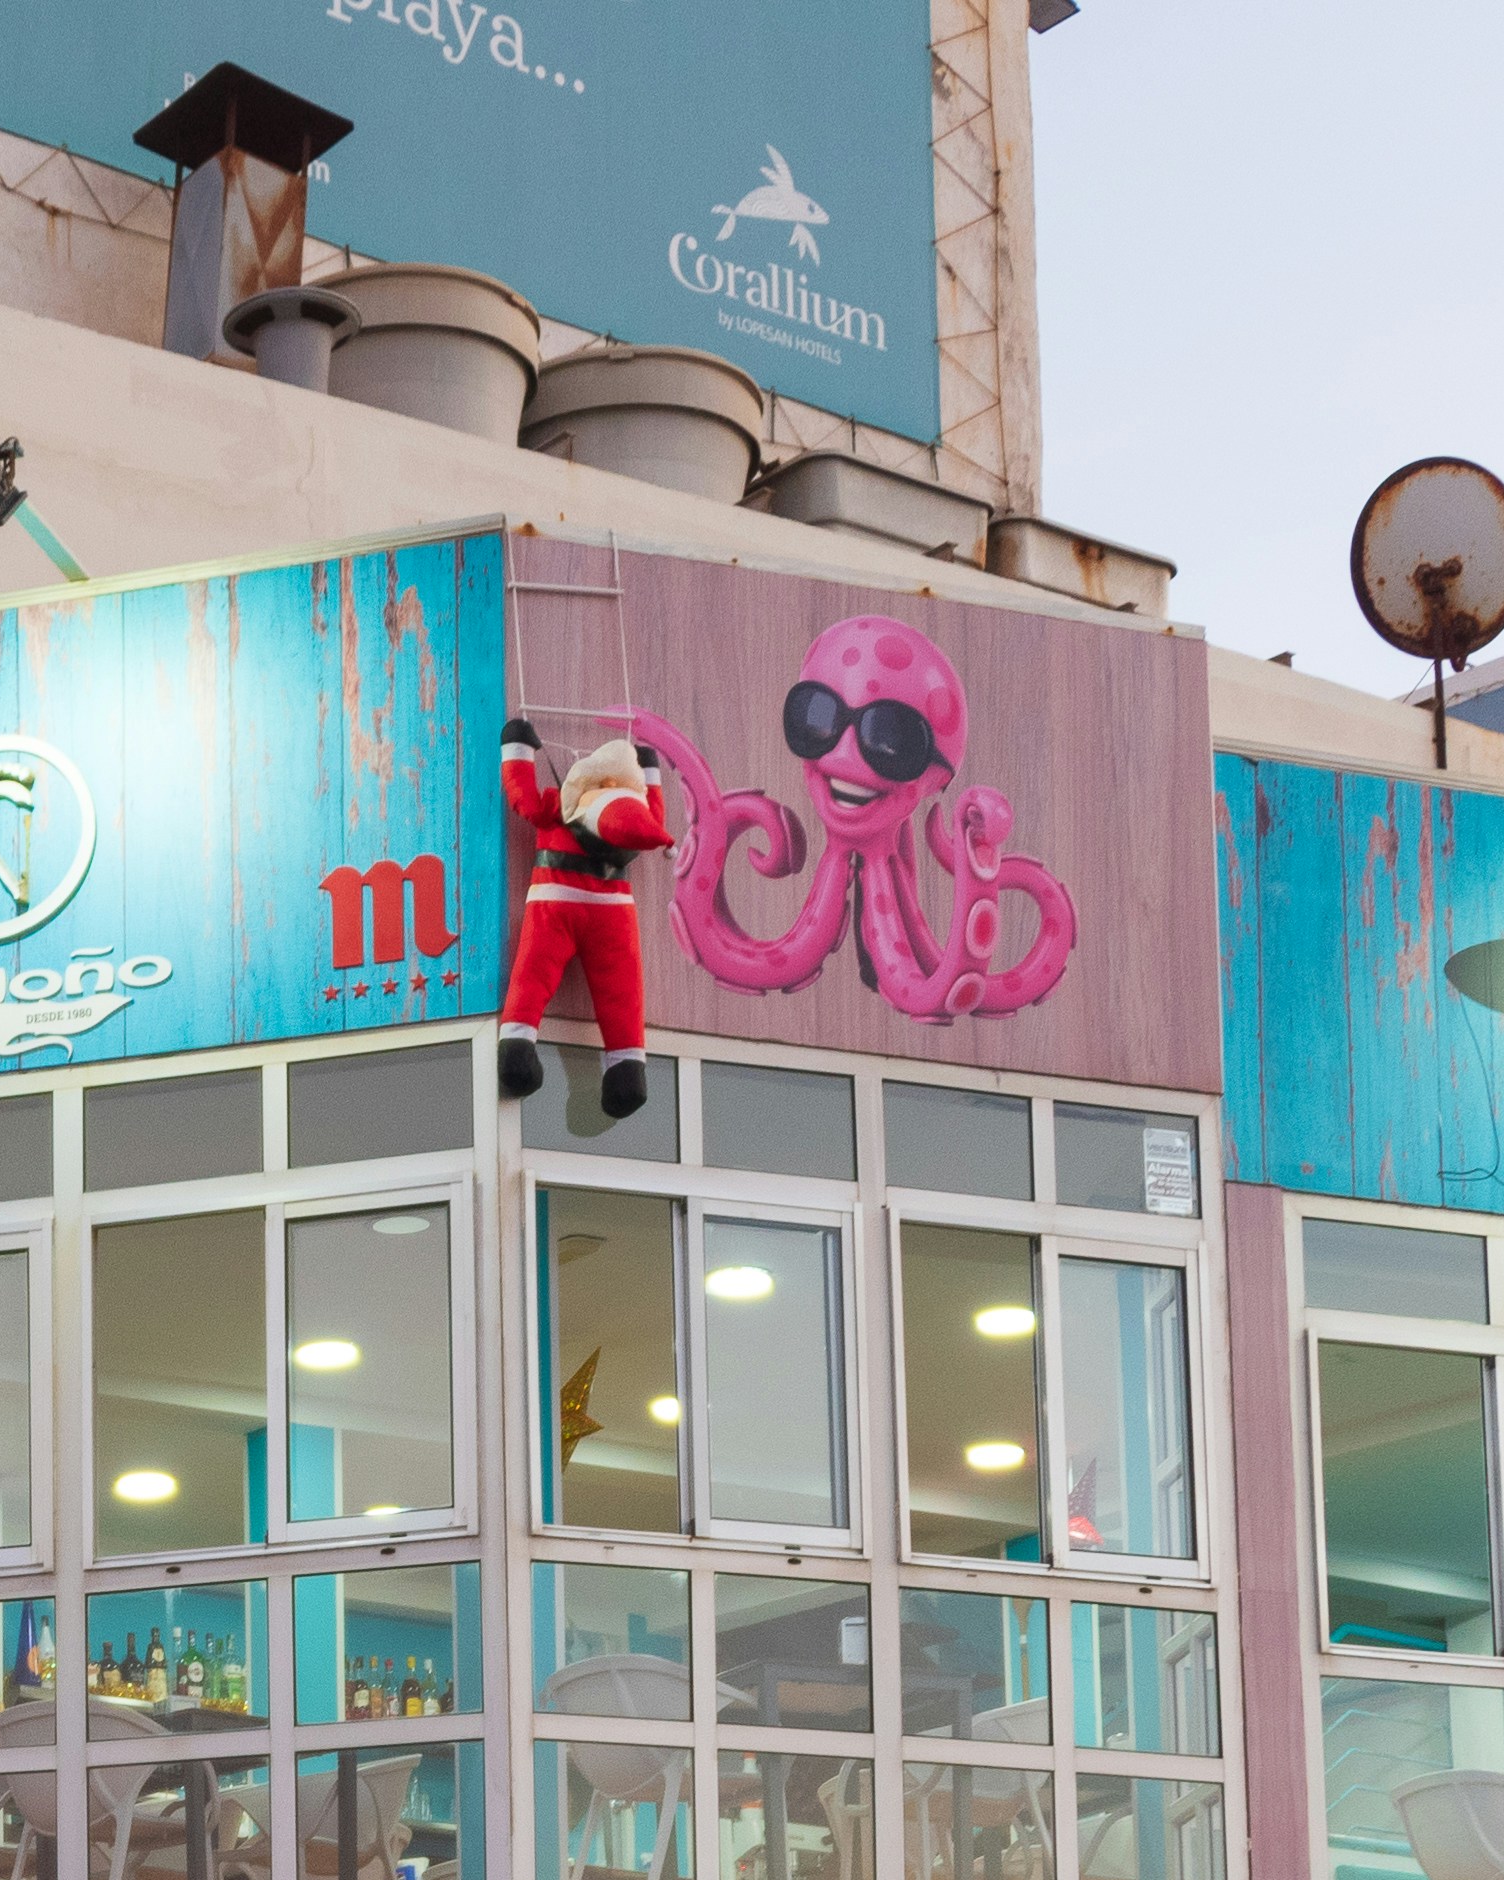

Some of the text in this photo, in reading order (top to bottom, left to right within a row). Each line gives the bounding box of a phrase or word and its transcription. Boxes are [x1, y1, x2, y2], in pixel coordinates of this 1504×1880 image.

[326, 0, 584, 94] aya...
[668, 232, 888, 351] Corallium
[718, 307, 842, 365] by LOPESAN HOTELS
[318, 853, 460, 968] m
[26, 1007, 92, 1025] DESDE 1980
